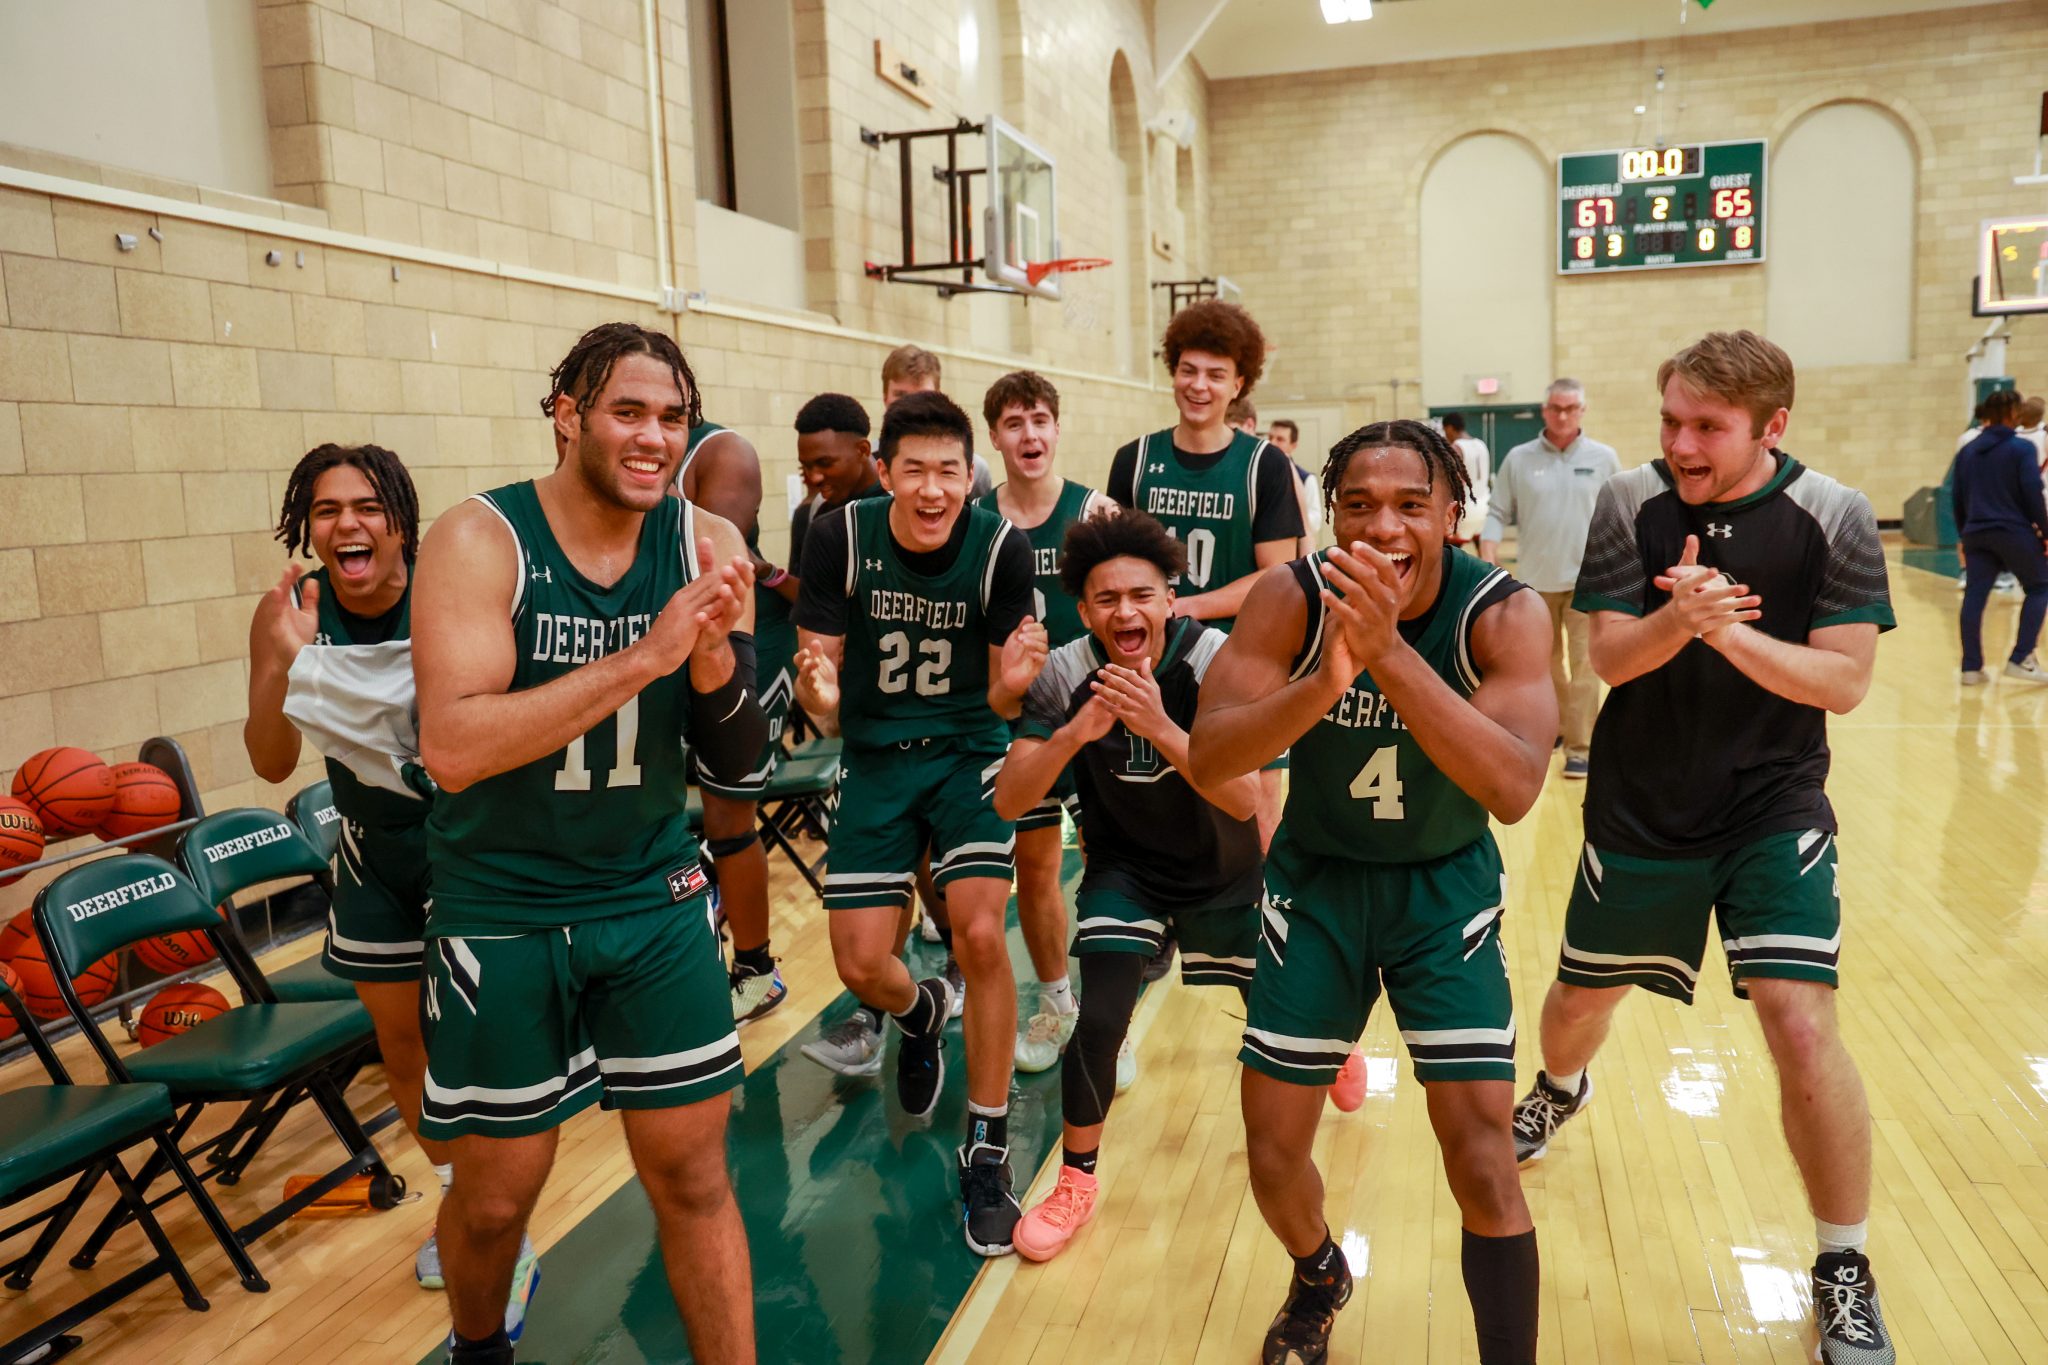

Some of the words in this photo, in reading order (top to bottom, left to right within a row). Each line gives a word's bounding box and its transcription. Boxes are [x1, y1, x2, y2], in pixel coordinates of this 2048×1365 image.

[1561, 183, 1623, 200] DEERFIELD
[1710, 173, 1753, 190] GUEST
[1577, 198, 1614, 228] 67
[1652, 196, 1669, 220] 2
[1715, 188, 1753, 218] 65
[1577, 235, 1593, 259] 8
[1607, 234, 1623, 257] 3
[1698, 227, 1715, 252] 0
[1735, 225, 1752, 249] 8
[1147, 486, 1234, 520] DEERFIELD
[1032, 547, 1062, 576] IEL
[870, 589, 967, 629] DEERFIELD
[532, 611, 663, 667] DEERIE
[877, 630, 953, 696] 22
[1348, 744, 1405, 820] 4
[202, 822, 292, 864] DEERFIELD
[66, 872, 177, 922] DEERFIELD
[163, 1010, 204, 1028] Wil
